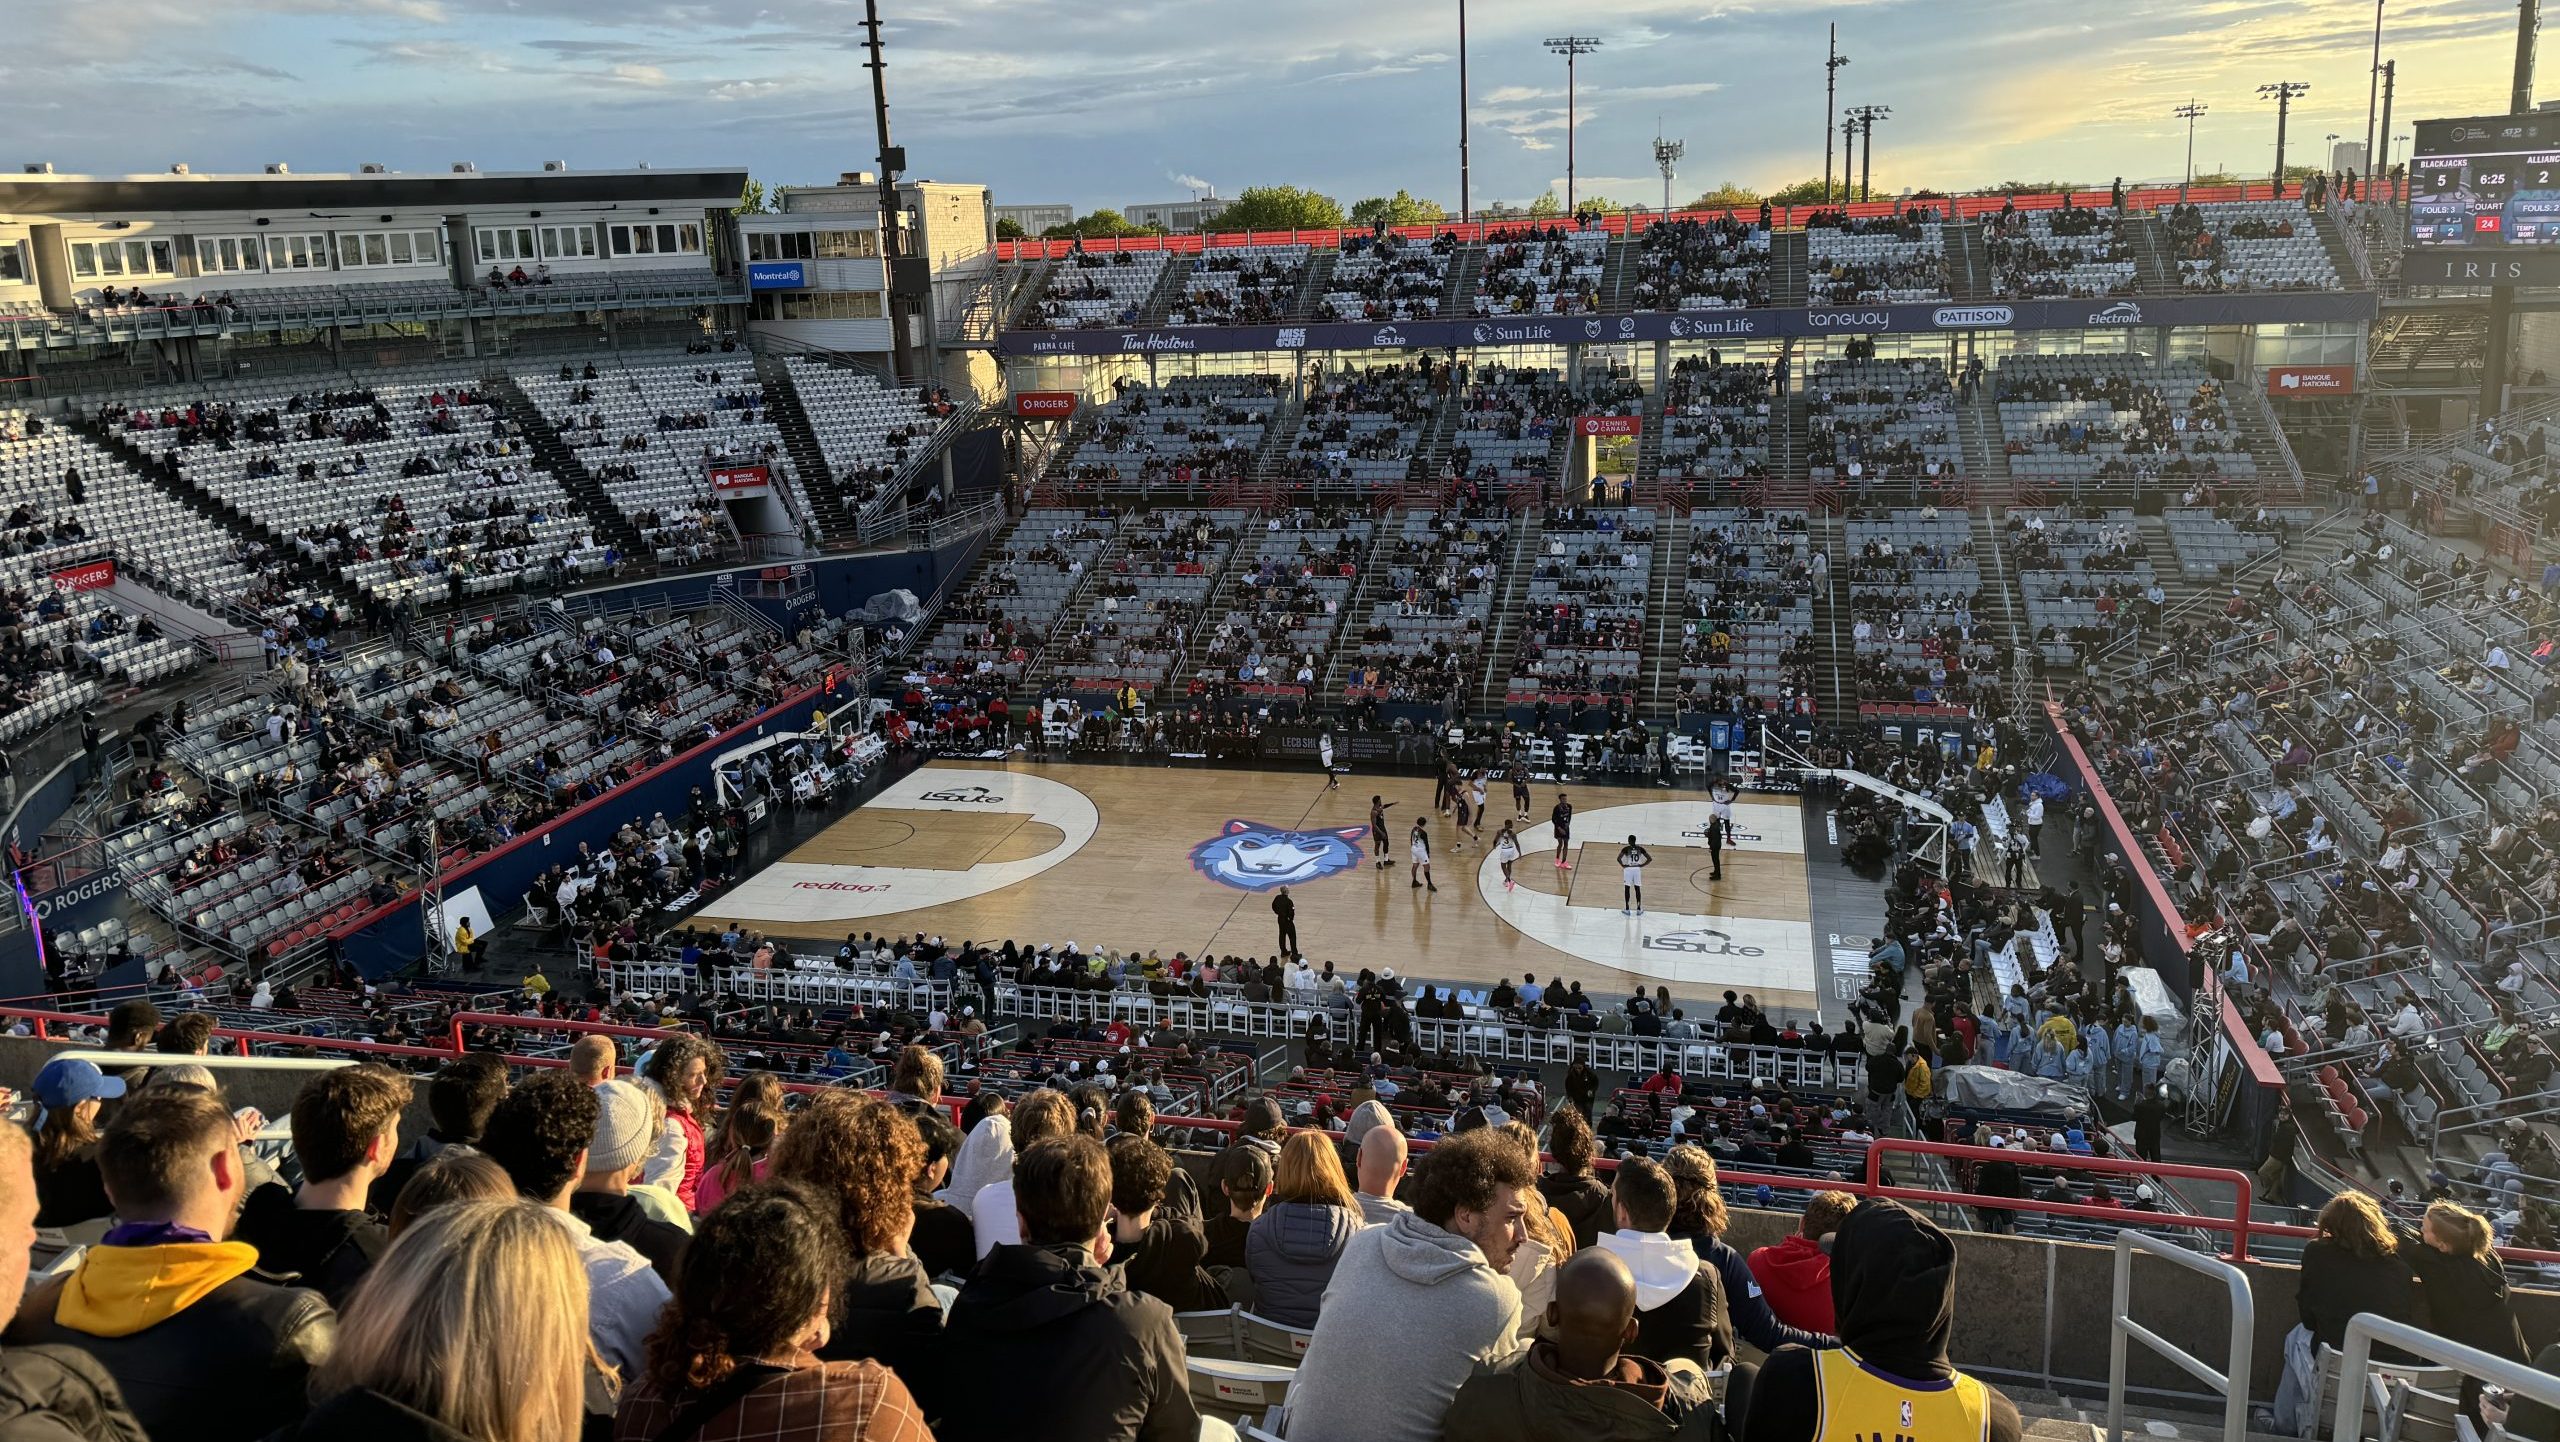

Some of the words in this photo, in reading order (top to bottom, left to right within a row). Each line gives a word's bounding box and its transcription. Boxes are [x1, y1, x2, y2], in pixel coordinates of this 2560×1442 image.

[2420, 159, 2468, 168] BLACKJACKS
[2437, 174, 2447, 186] 5
[2480, 174, 2505, 185] 6:25
[2538, 171, 2549, 184] 2
[2422, 206, 2450, 214] FOULS:
[2450, 206, 2456, 214] 3
[2475, 202, 2504, 211] QUART
[2523, 204, 2552, 212] FOULS:
[2553, 204, 2560, 212] 2
[2481, 219, 2494, 229] 24
[2447, 228, 2455, 237] 2
[2551, 226, 2559, 236] 2
[754, 271, 789, 280] Montréal
[2445, 262, 2521, 278] IRIS
[1808, 310, 1889, 330] tanguay
[1940, 311, 2007, 324] PATTISON
[2088, 312, 2143, 325] Electrolit
[1694, 320, 1723, 334] Sun
[1726, 318, 1754, 333] Life
[1278, 328, 1307, 338] MISE
[1496, 327, 1523, 340] Sun
[1525, 325, 1552, 339] Life
[1033, 342, 1057, 351] PARMA
[1059, 340, 1076, 350] CAFÉ
[1121, 334, 1145, 350] Tim
[1147, 333, 1196, 350] Hortons
[1033, 400, 1069, 409] ROGERS
[68, 569, 109, 587] ROGERS
[792, 590, 816, 607] ROGERS
[1630, 854, 1640, 863] 10
[55, 871, 122, 911] ROGERS
